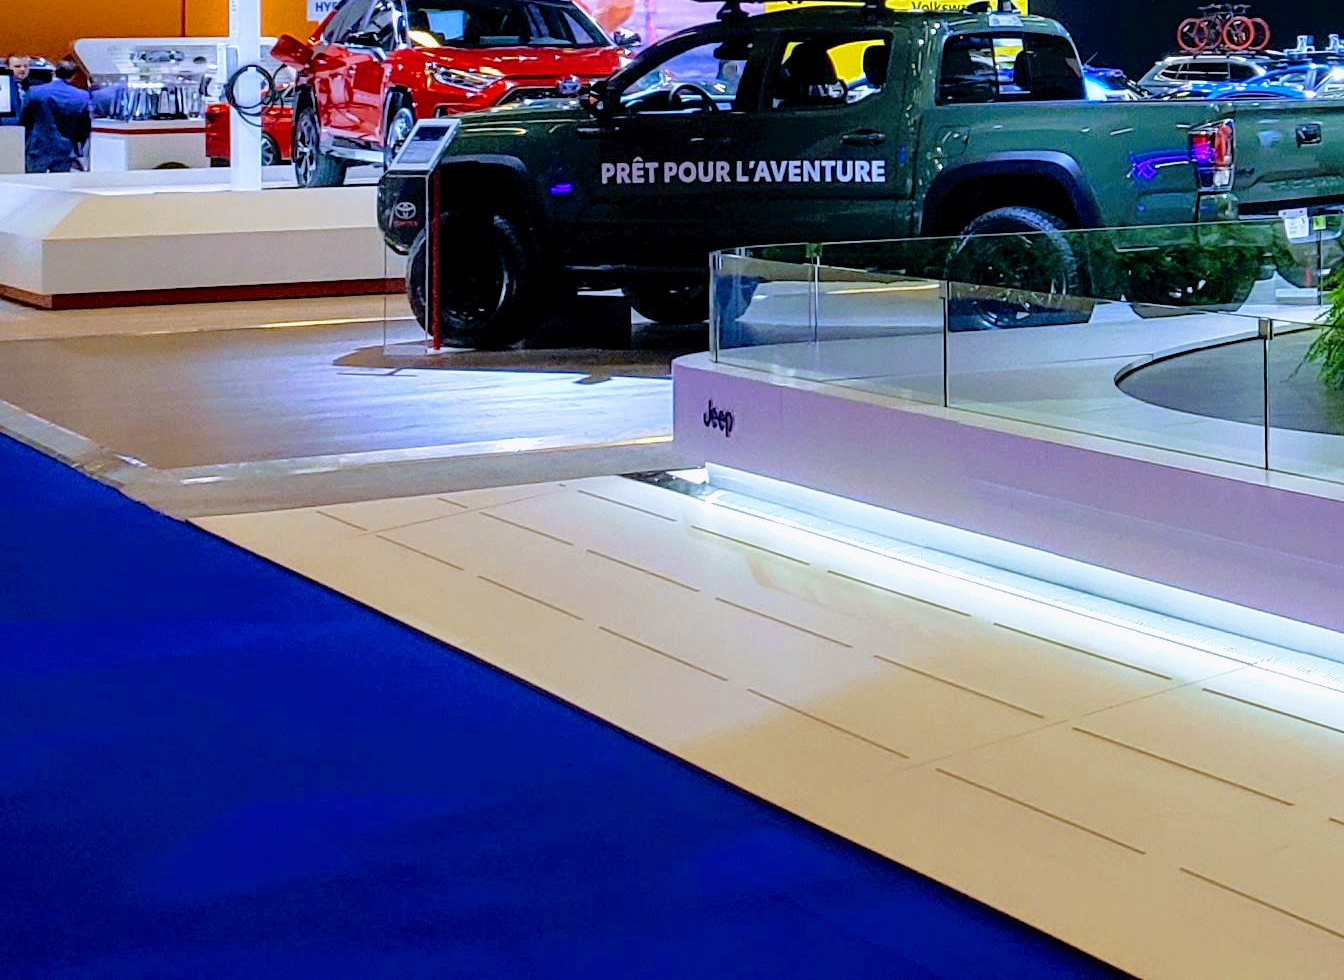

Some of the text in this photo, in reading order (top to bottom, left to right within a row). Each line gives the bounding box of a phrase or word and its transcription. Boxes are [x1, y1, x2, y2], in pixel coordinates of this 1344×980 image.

[601, 156, 886, 185] PRÊT POUR L'AVENTURE
[703, 399, 733, 438] Jeep
